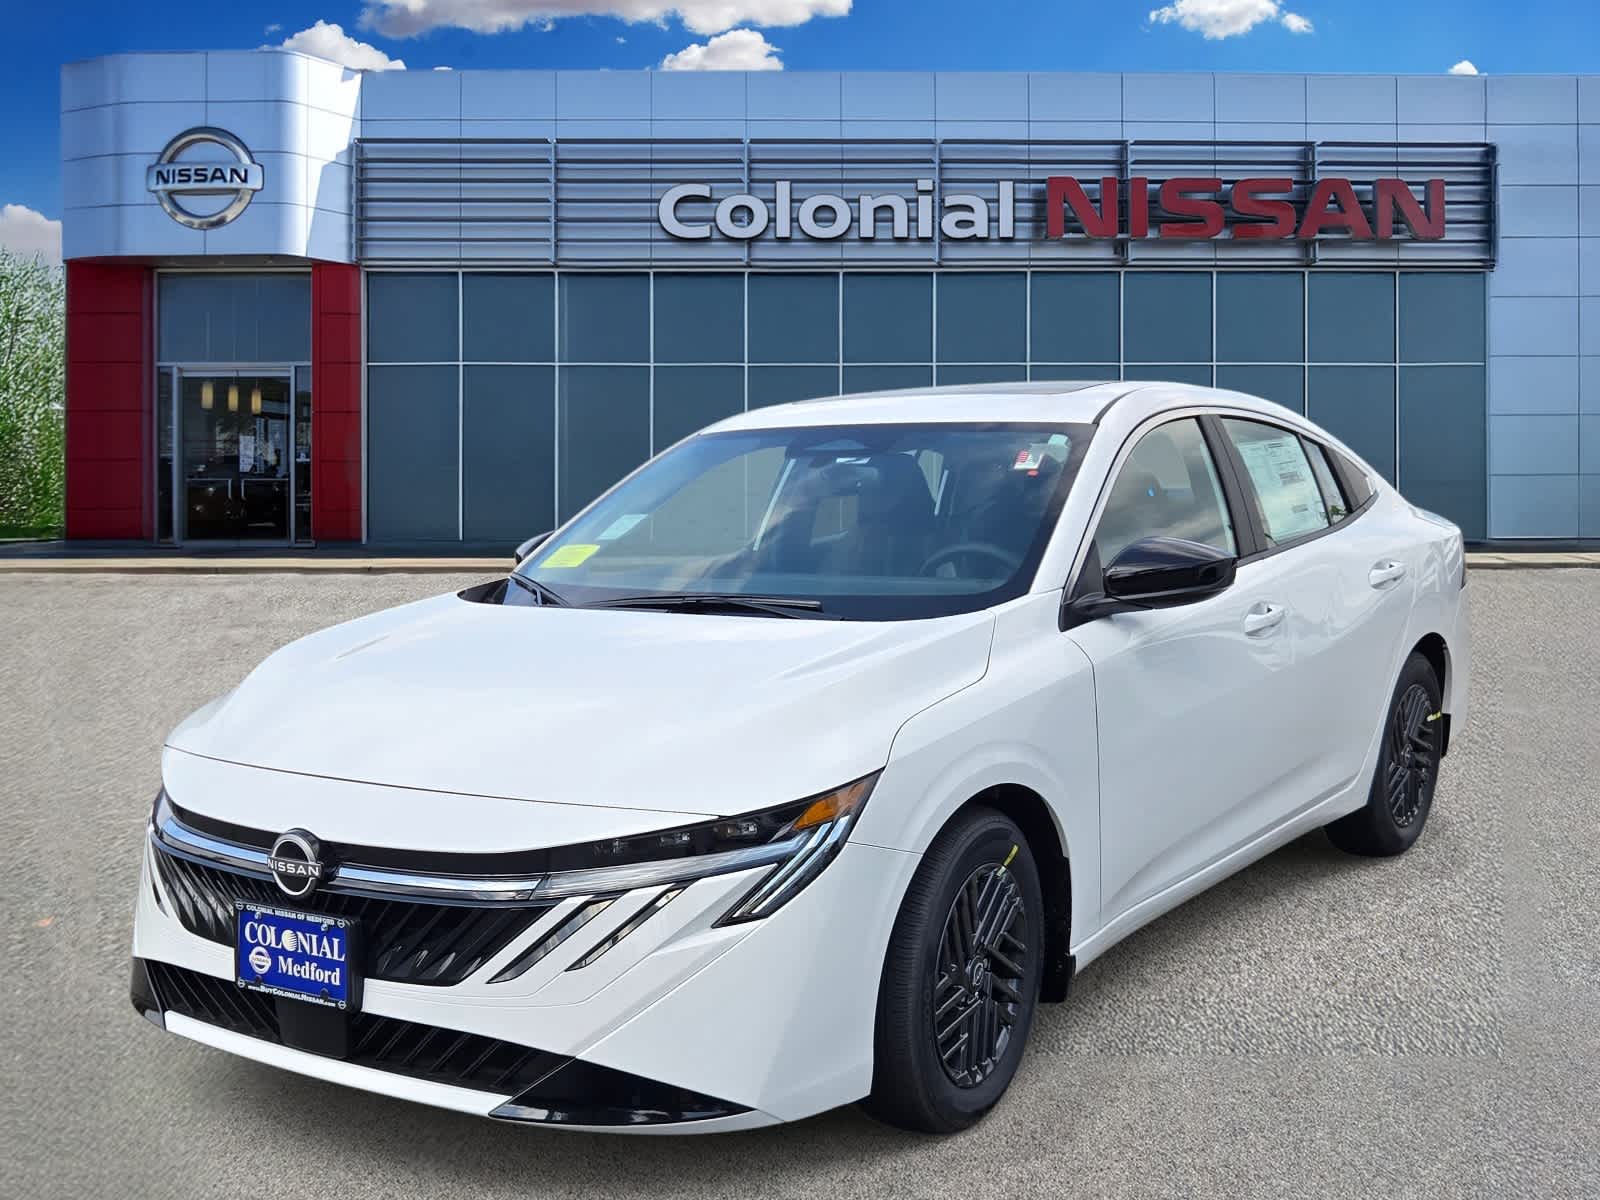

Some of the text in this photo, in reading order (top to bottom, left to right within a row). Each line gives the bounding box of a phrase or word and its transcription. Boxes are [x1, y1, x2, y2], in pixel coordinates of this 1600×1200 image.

[155, 167, 248, 185] NISSAN
[658, 176, 1446, 240] Colonial NISSAN
[267, 858, 320, 876] NISSAN
[246, 904, 335, 926] COLONIAL NISSAN OF MEDFORD
[244, 921, 346, 962] COLONIAL
[278, 955, 341, 986] Medford
